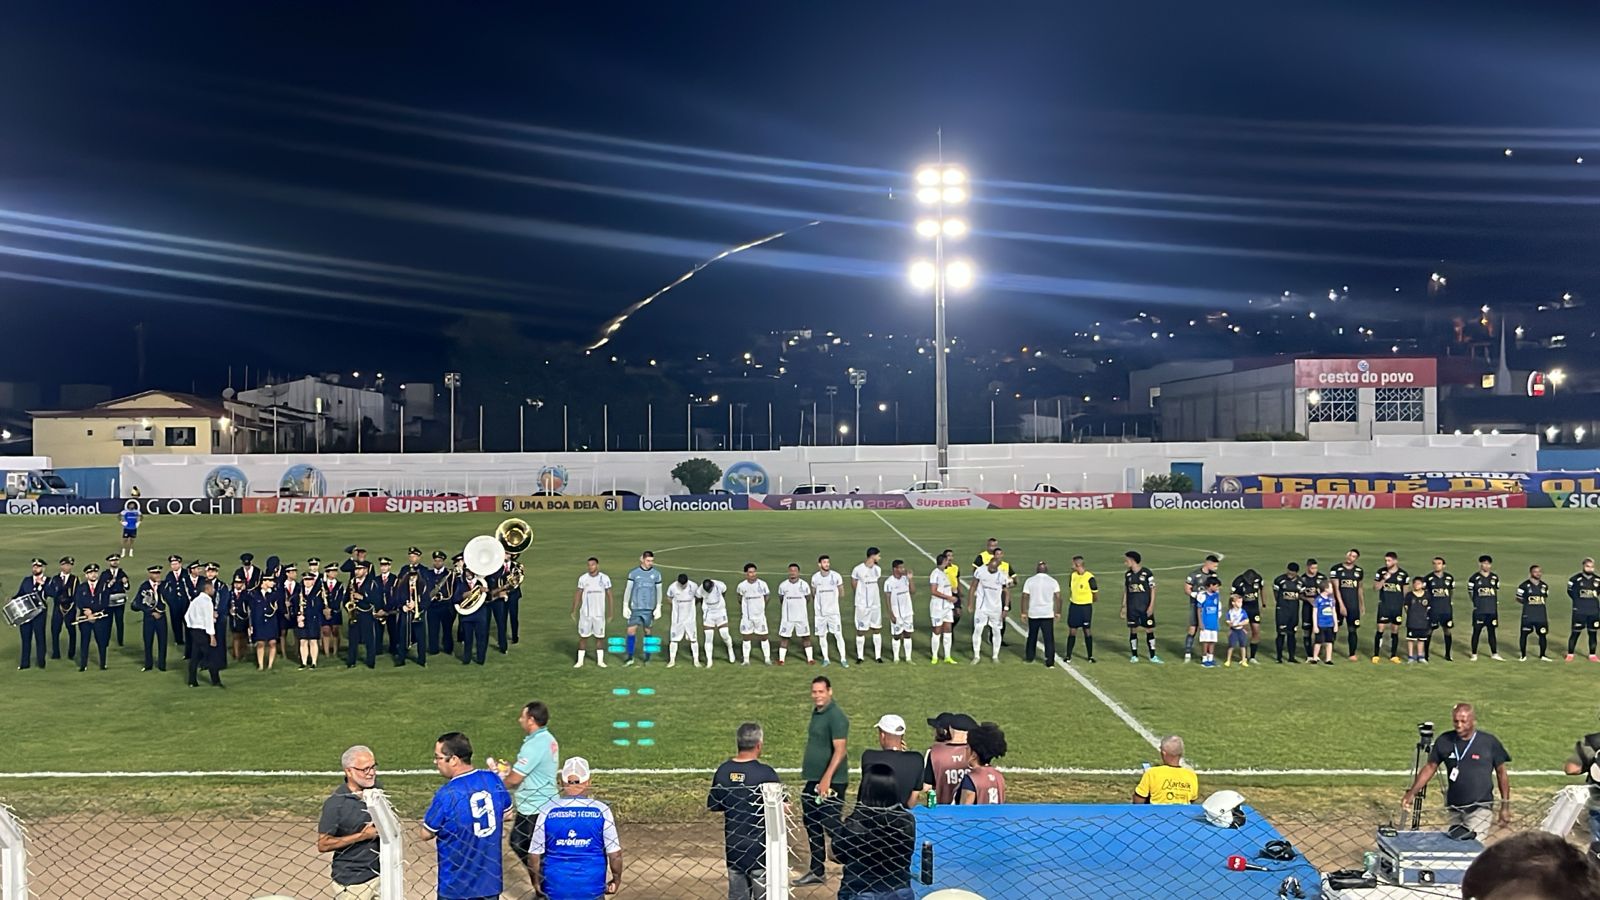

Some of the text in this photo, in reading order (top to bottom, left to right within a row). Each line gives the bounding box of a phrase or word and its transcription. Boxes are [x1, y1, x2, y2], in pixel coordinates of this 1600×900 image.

[1319, 371, 1414, 386] cesta do povo
[1245, 475, 1428, 494] JEGUE
[9, 500, 101, 515] betnacional
[277, 498, 355, 514] BETANO
[385, 496, 479, 513] SUPERBET
[503, 499, 616, 510] 51 UMA BOA IDEIA 51
[640, 495, 733, 511] betnacional
[796, 498, 906, 510] BAIANÃO 2024
[916, 498, 972, 508] SUPERBET
[1018, 493, 1113, 510] SUPERBET
[1151, 493, 1244, 509] betnacional
[1300, 494, 1376, 509] BETANO
[1411, 493, 1510, 509] SUPERBET
[469, 790, 497, 838] 9
